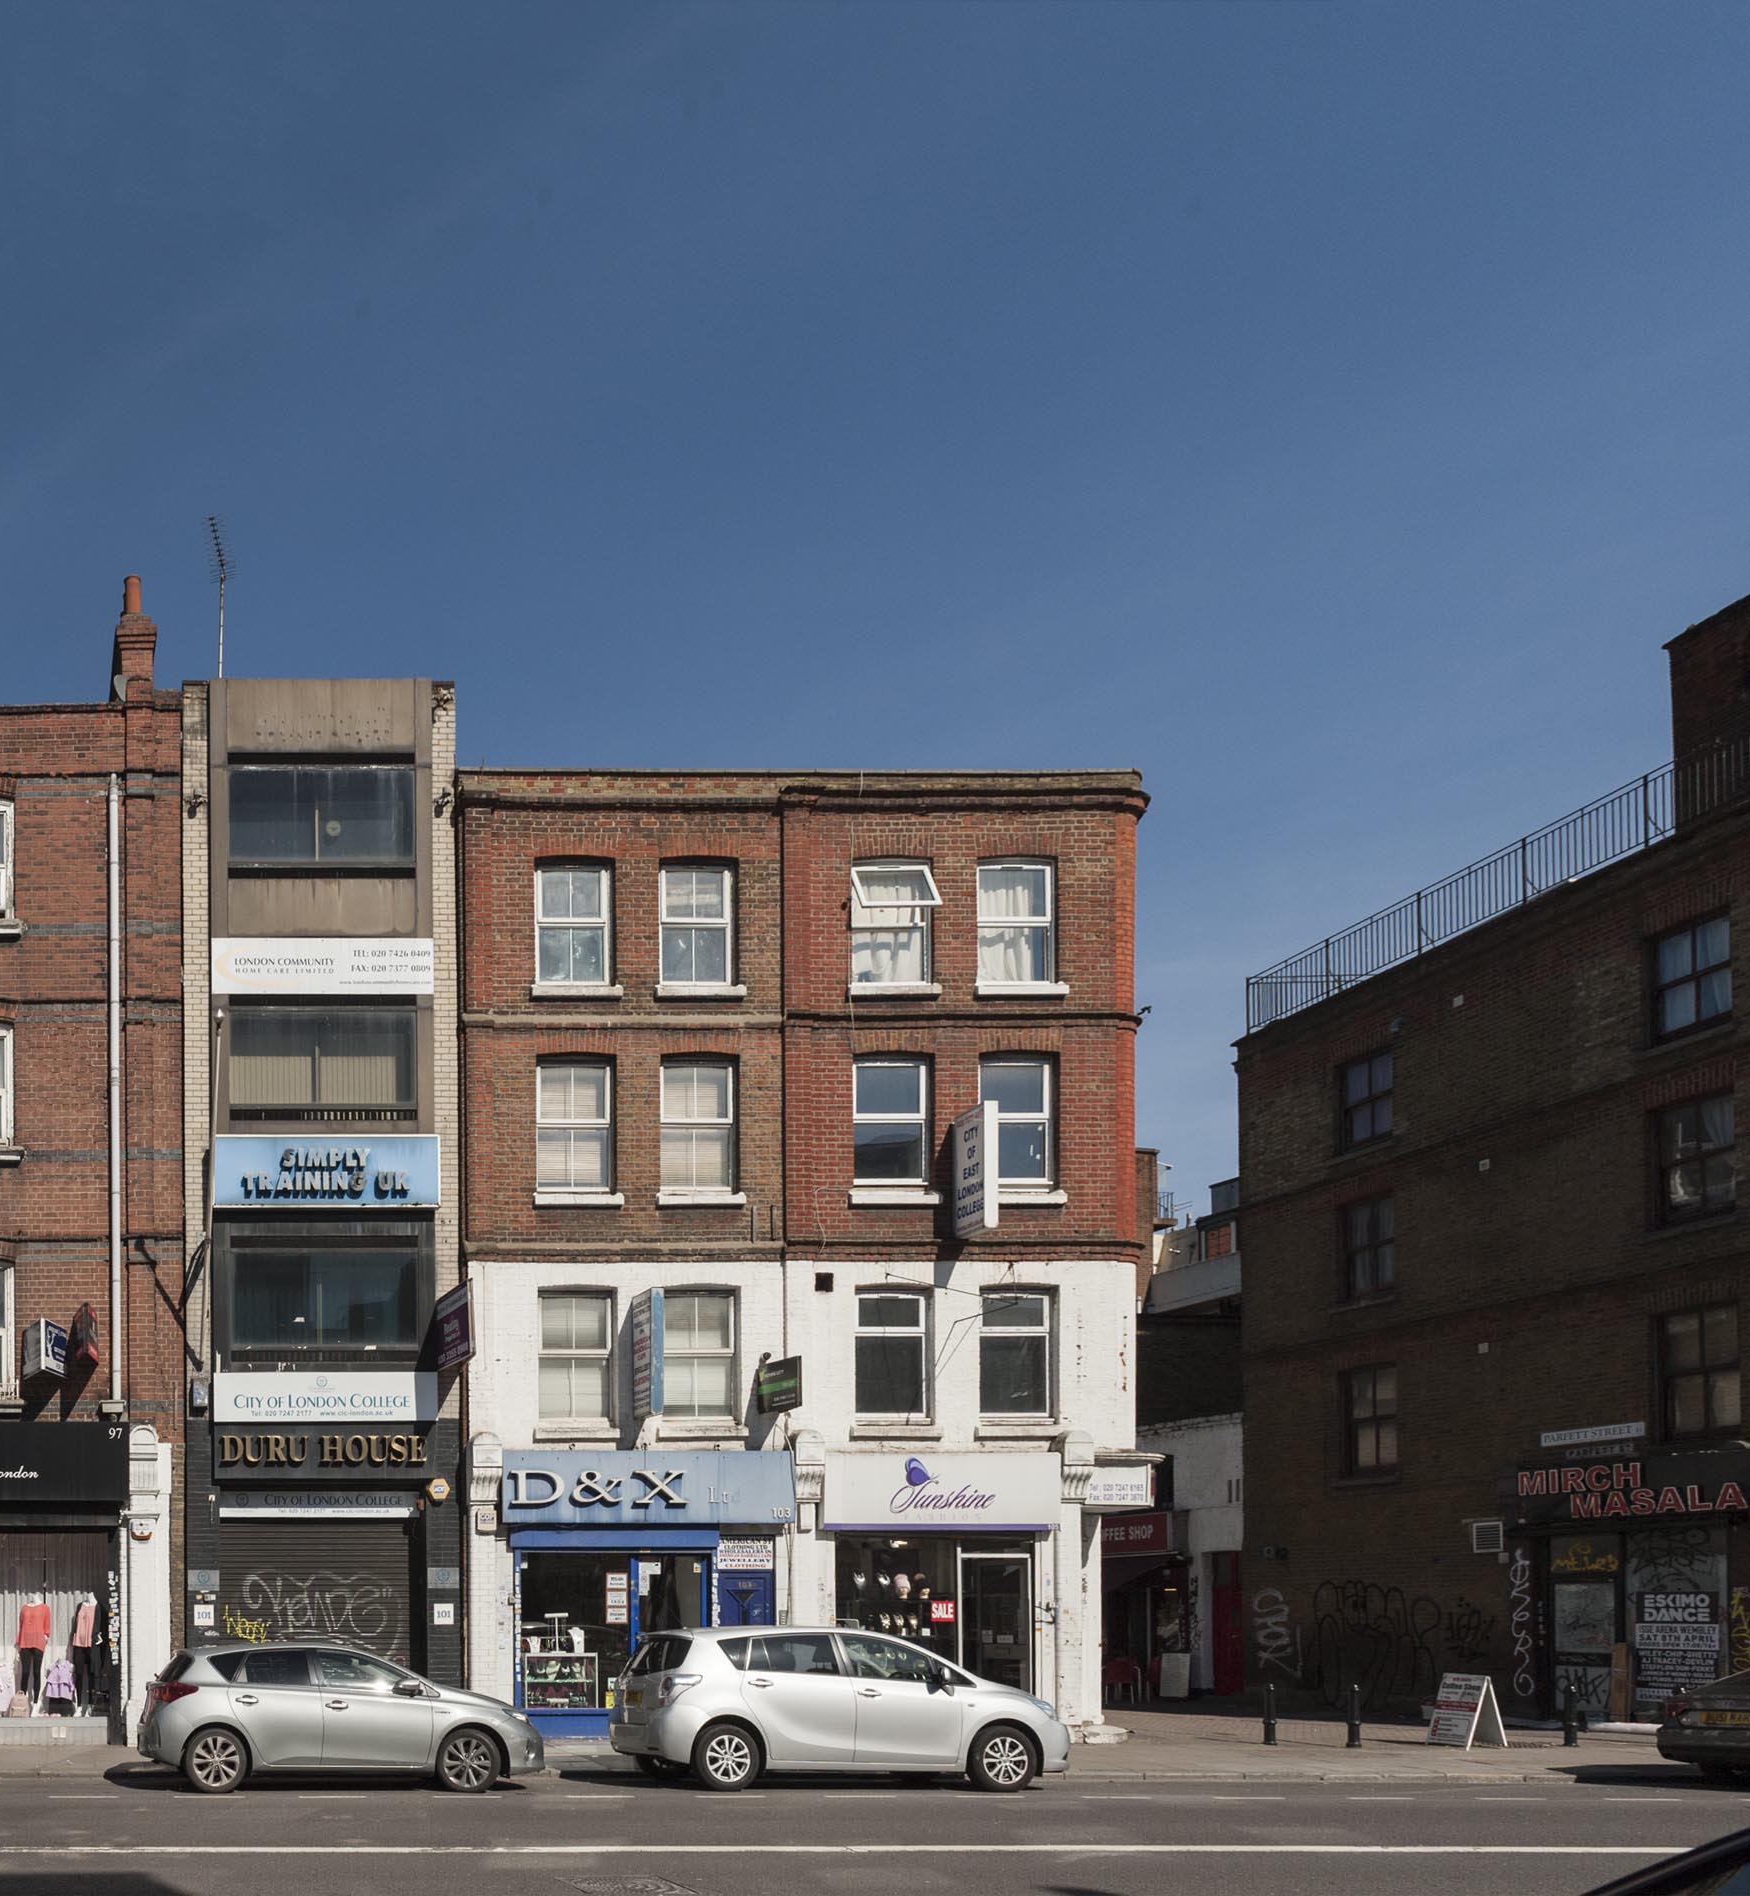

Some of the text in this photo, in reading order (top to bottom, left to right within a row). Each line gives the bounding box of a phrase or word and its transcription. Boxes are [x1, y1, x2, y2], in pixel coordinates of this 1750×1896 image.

[235, 958, 335, 966] LONDON COMMUNITY
[964, 1125, 980, 1143] CITY
[281, 1148, 371, 1168] SIMPLY
[967, 1145, 976, 1160] OF
[963, 1162, 980, 1180] EAST
[243, 1171, 411, 1192] TRAINING UK
[958, 1181, 984, 1200] LONDON
[957, 1198, 984, 1220] COLLEGE
[234, 1393, 410, 1409] CITY OF LONDON COLLEGE
[108, 1427, 123, 1440] 97
[1543, 1429, 1588, 1444] PARFETT
[1591, 1425, 1632, 1438] STREET
[220, 1435, 428, 1463] DURU HOUSE
[1517, 1462, 1642, 1497] MIRCH
[510, 1469, 689, 1507] D&X
[889, 1478, 997, 1514] Sunshine
[265, 1494, 403, 1505] CITY OF LONDON COLLEGE
[1103, 1493, 1114, 1501] 020
[1115, 1493, 1129, 1501] 7247
[1569, 1481, 1750, 1519] MASALA
[772, 1507, 791, 1519] 103
[1101, 1524, 1154, 1541] FFEE SHOP
[1643, 1594, 1711, 1608] ESKIMO
[197, 1611, 211, 1619] 101
[437, 1610, 451, 1619] 101
[931, 1603, 954, 1619] SALE
[1643, 1608, 1711, 1622] DANCE
[1655, 1626, 1678, 1634] ARENA
[1680, 1626, 1716, 1635] WEMBLEY
[1661, 1634, 1680, 1642] 8TH
[1684, 1634, 1715, 1643] APRIL
[1441, 1682, 1463, 1690] Coffee
